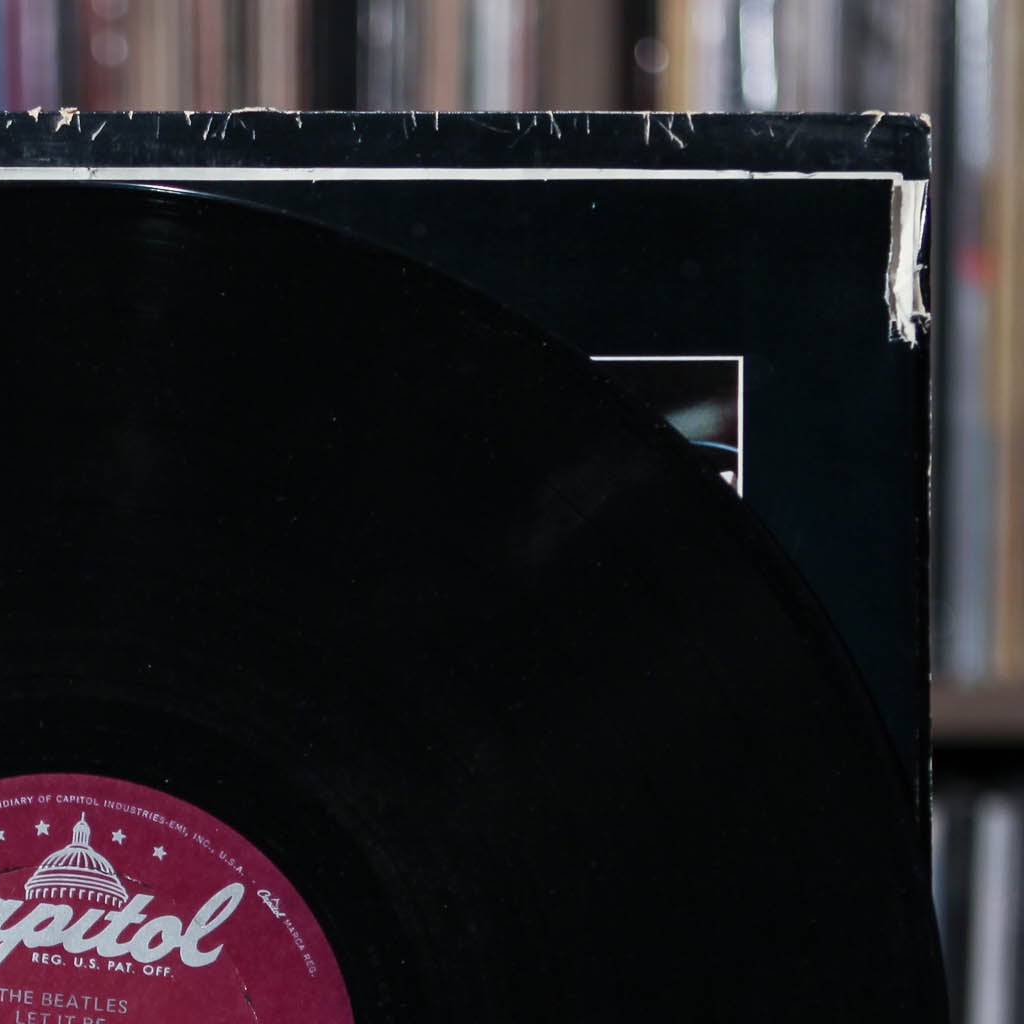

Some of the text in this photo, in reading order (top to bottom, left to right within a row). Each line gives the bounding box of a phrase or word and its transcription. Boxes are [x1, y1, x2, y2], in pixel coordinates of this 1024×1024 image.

[37, 794, 52, 805] OF
[55, 794, 100, 807] CAPITOL
[218, 850, 246, 877] U.S.A.
[31, 951, 176, 979] REG. U.S. PAT. OFF.
[284, 918, 306, 951] MARCA
[303, 952, 318, 978] REG.
[41, 992, 129, 1014] BEATLES
